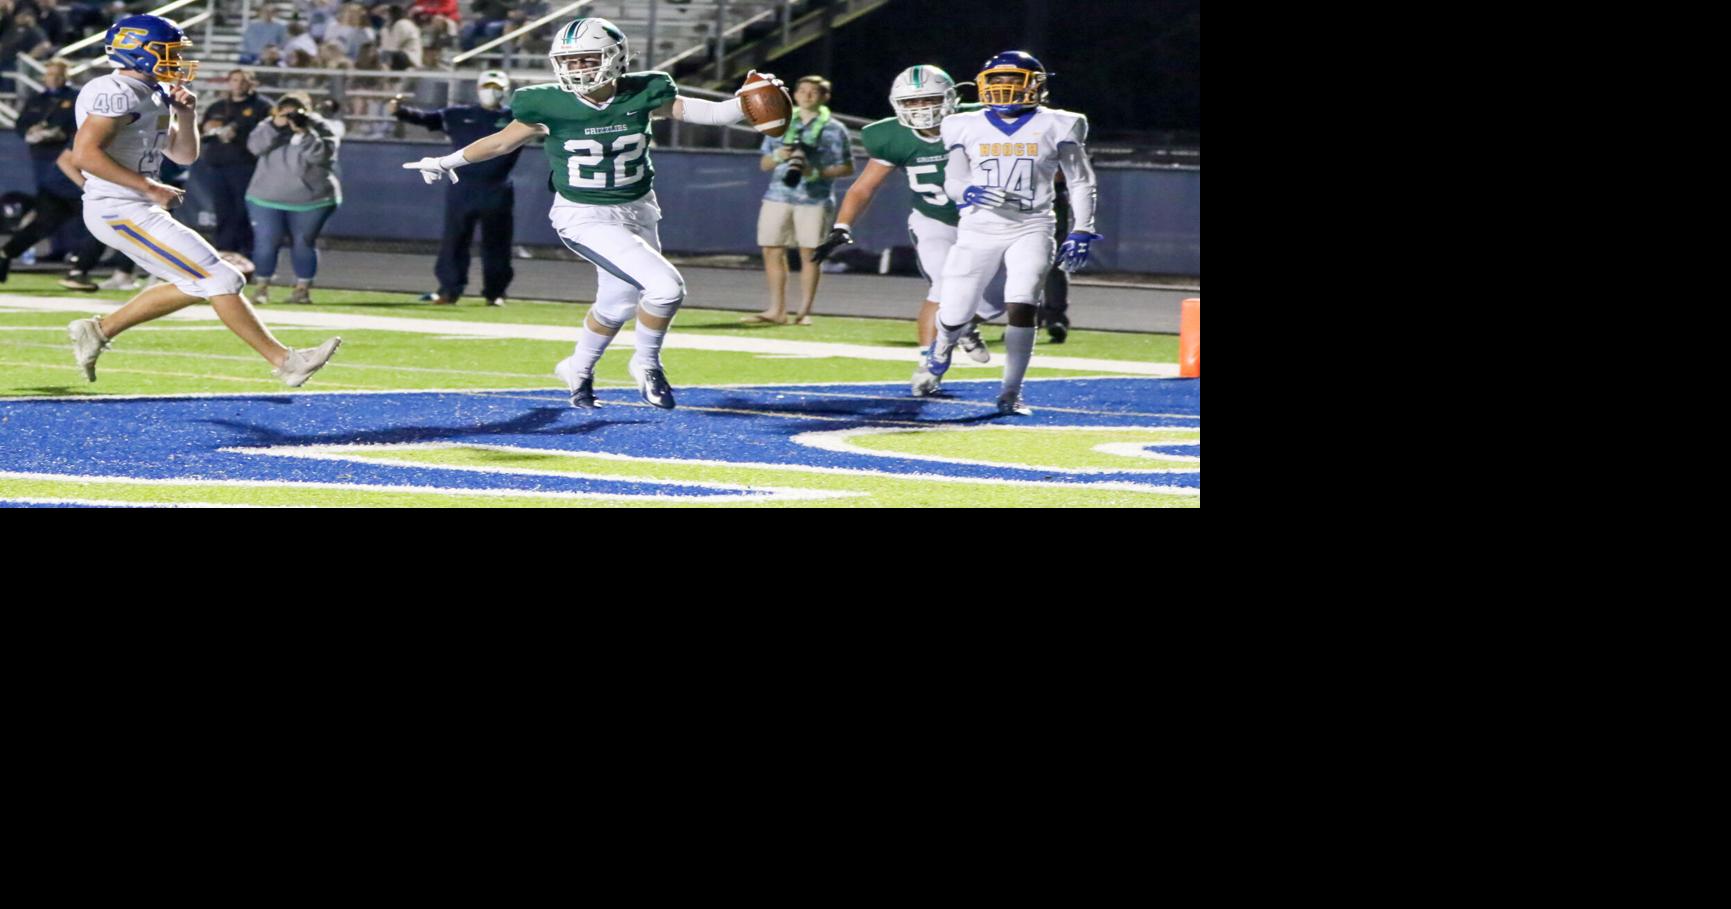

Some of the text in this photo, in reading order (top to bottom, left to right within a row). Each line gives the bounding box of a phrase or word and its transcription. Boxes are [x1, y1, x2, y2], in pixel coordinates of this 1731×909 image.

[93, 92, 129, 114] 40
[563, 132, 646, 188] 22
[979, 142, 1040, 157] HOOCH
[978, 158, 1035, 211] 14
